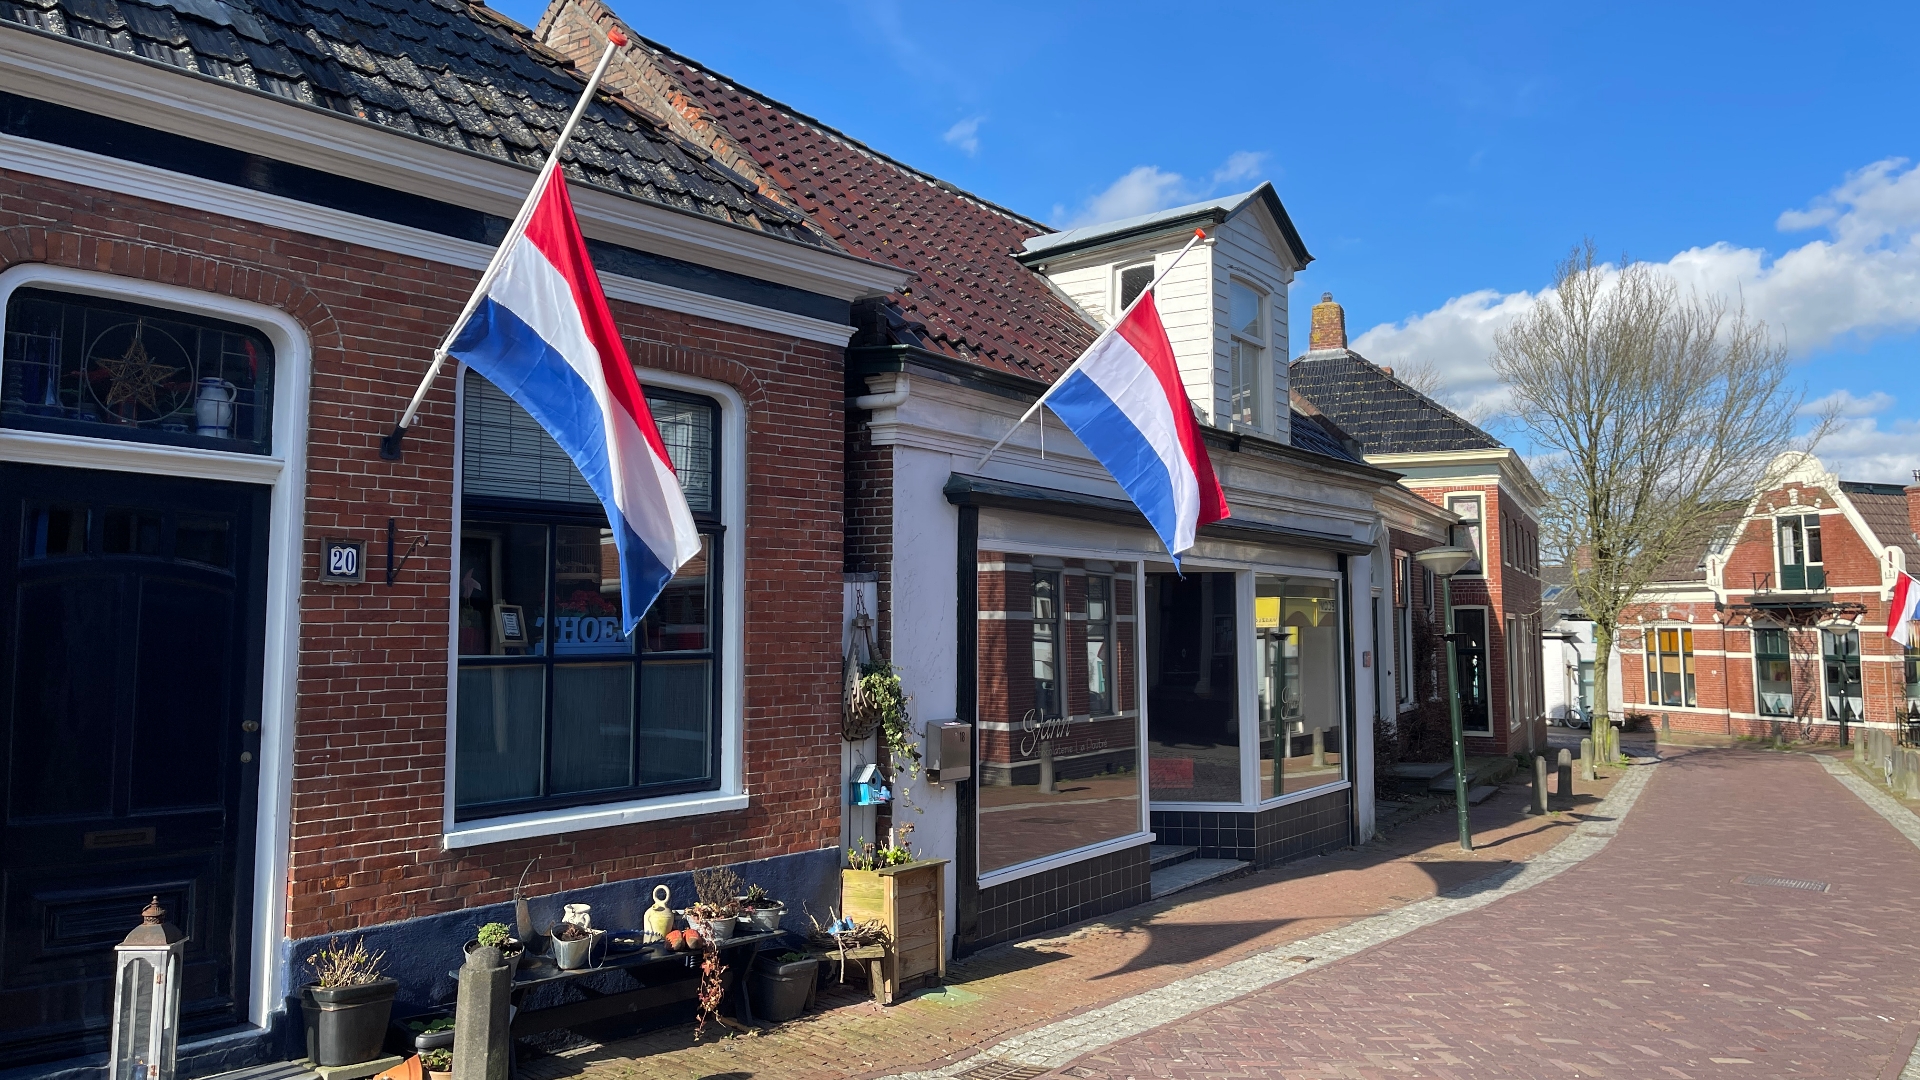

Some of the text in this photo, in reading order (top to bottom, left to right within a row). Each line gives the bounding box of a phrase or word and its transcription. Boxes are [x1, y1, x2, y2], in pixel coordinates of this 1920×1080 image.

[333, 549, 355, 572] 20
[534, 616, 628, 643] HOE
[959, 731, 966, 743] 18
